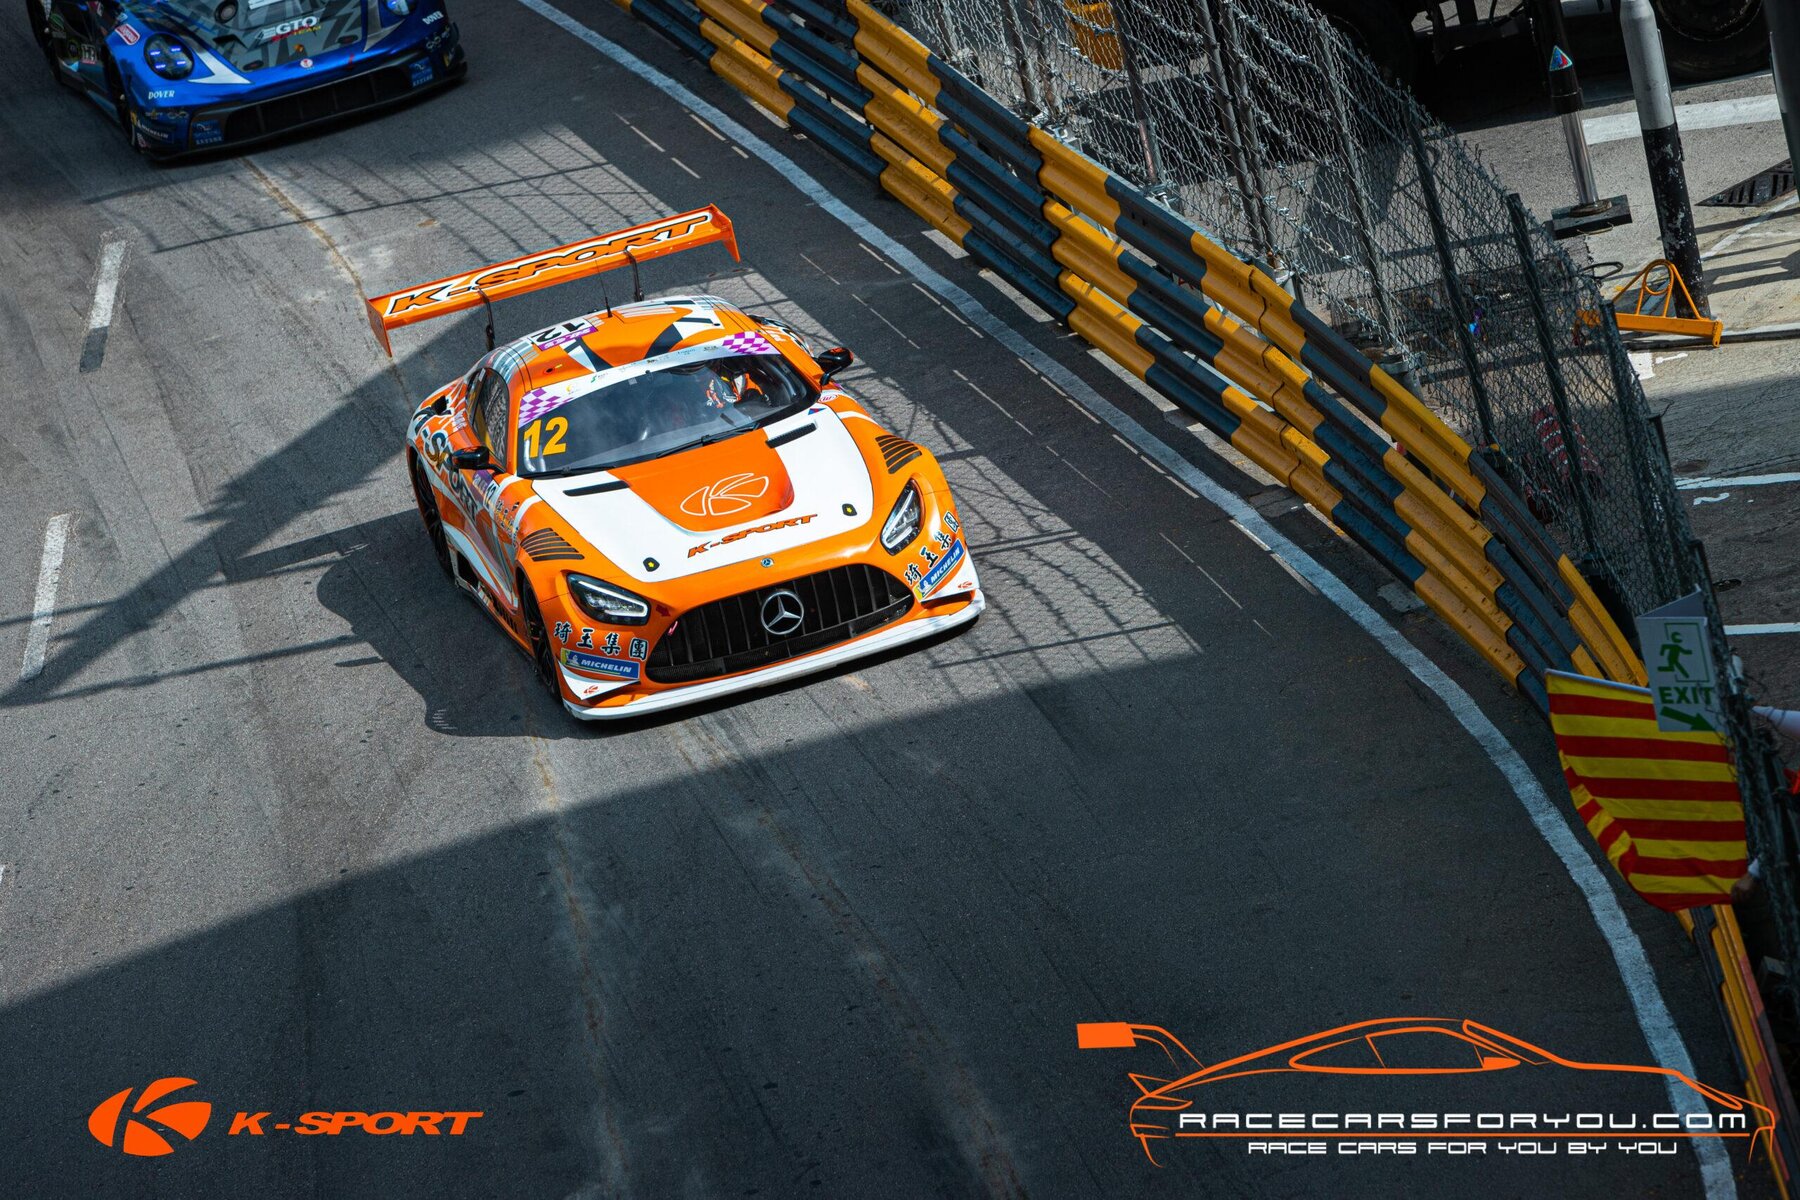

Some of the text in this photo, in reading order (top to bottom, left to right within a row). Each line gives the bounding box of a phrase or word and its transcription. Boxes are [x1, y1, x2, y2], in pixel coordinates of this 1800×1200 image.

[148, 90, 175, 100] DOVER
[391, 215, 710, 314] K-SPORT
[531, 323, 586, 342] 12
[524, 416, 568, 458] 12
[687, 513, 818, 559] K-SPORT
[930, 546, 960, 583] MICHELIN
[580, 659, 632, 673] MICHELIN
[1659, 686, 1714, 705] EXIT
